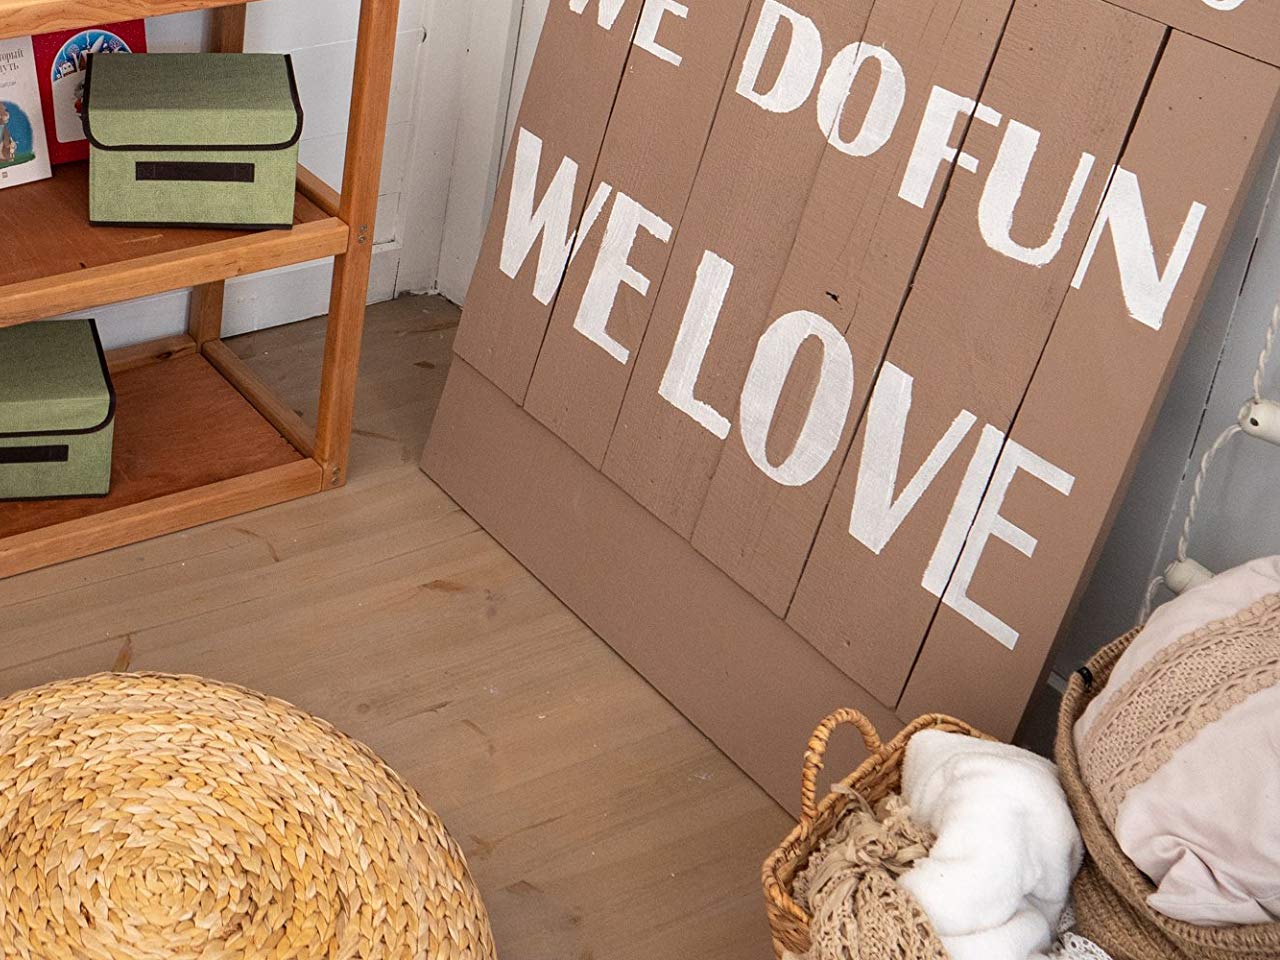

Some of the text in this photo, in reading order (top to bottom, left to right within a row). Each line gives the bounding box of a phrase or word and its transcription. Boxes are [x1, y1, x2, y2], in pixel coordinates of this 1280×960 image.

[499, 127, 1076, 651] WE LOVE
[897, 84, 1207, 331] FUN
